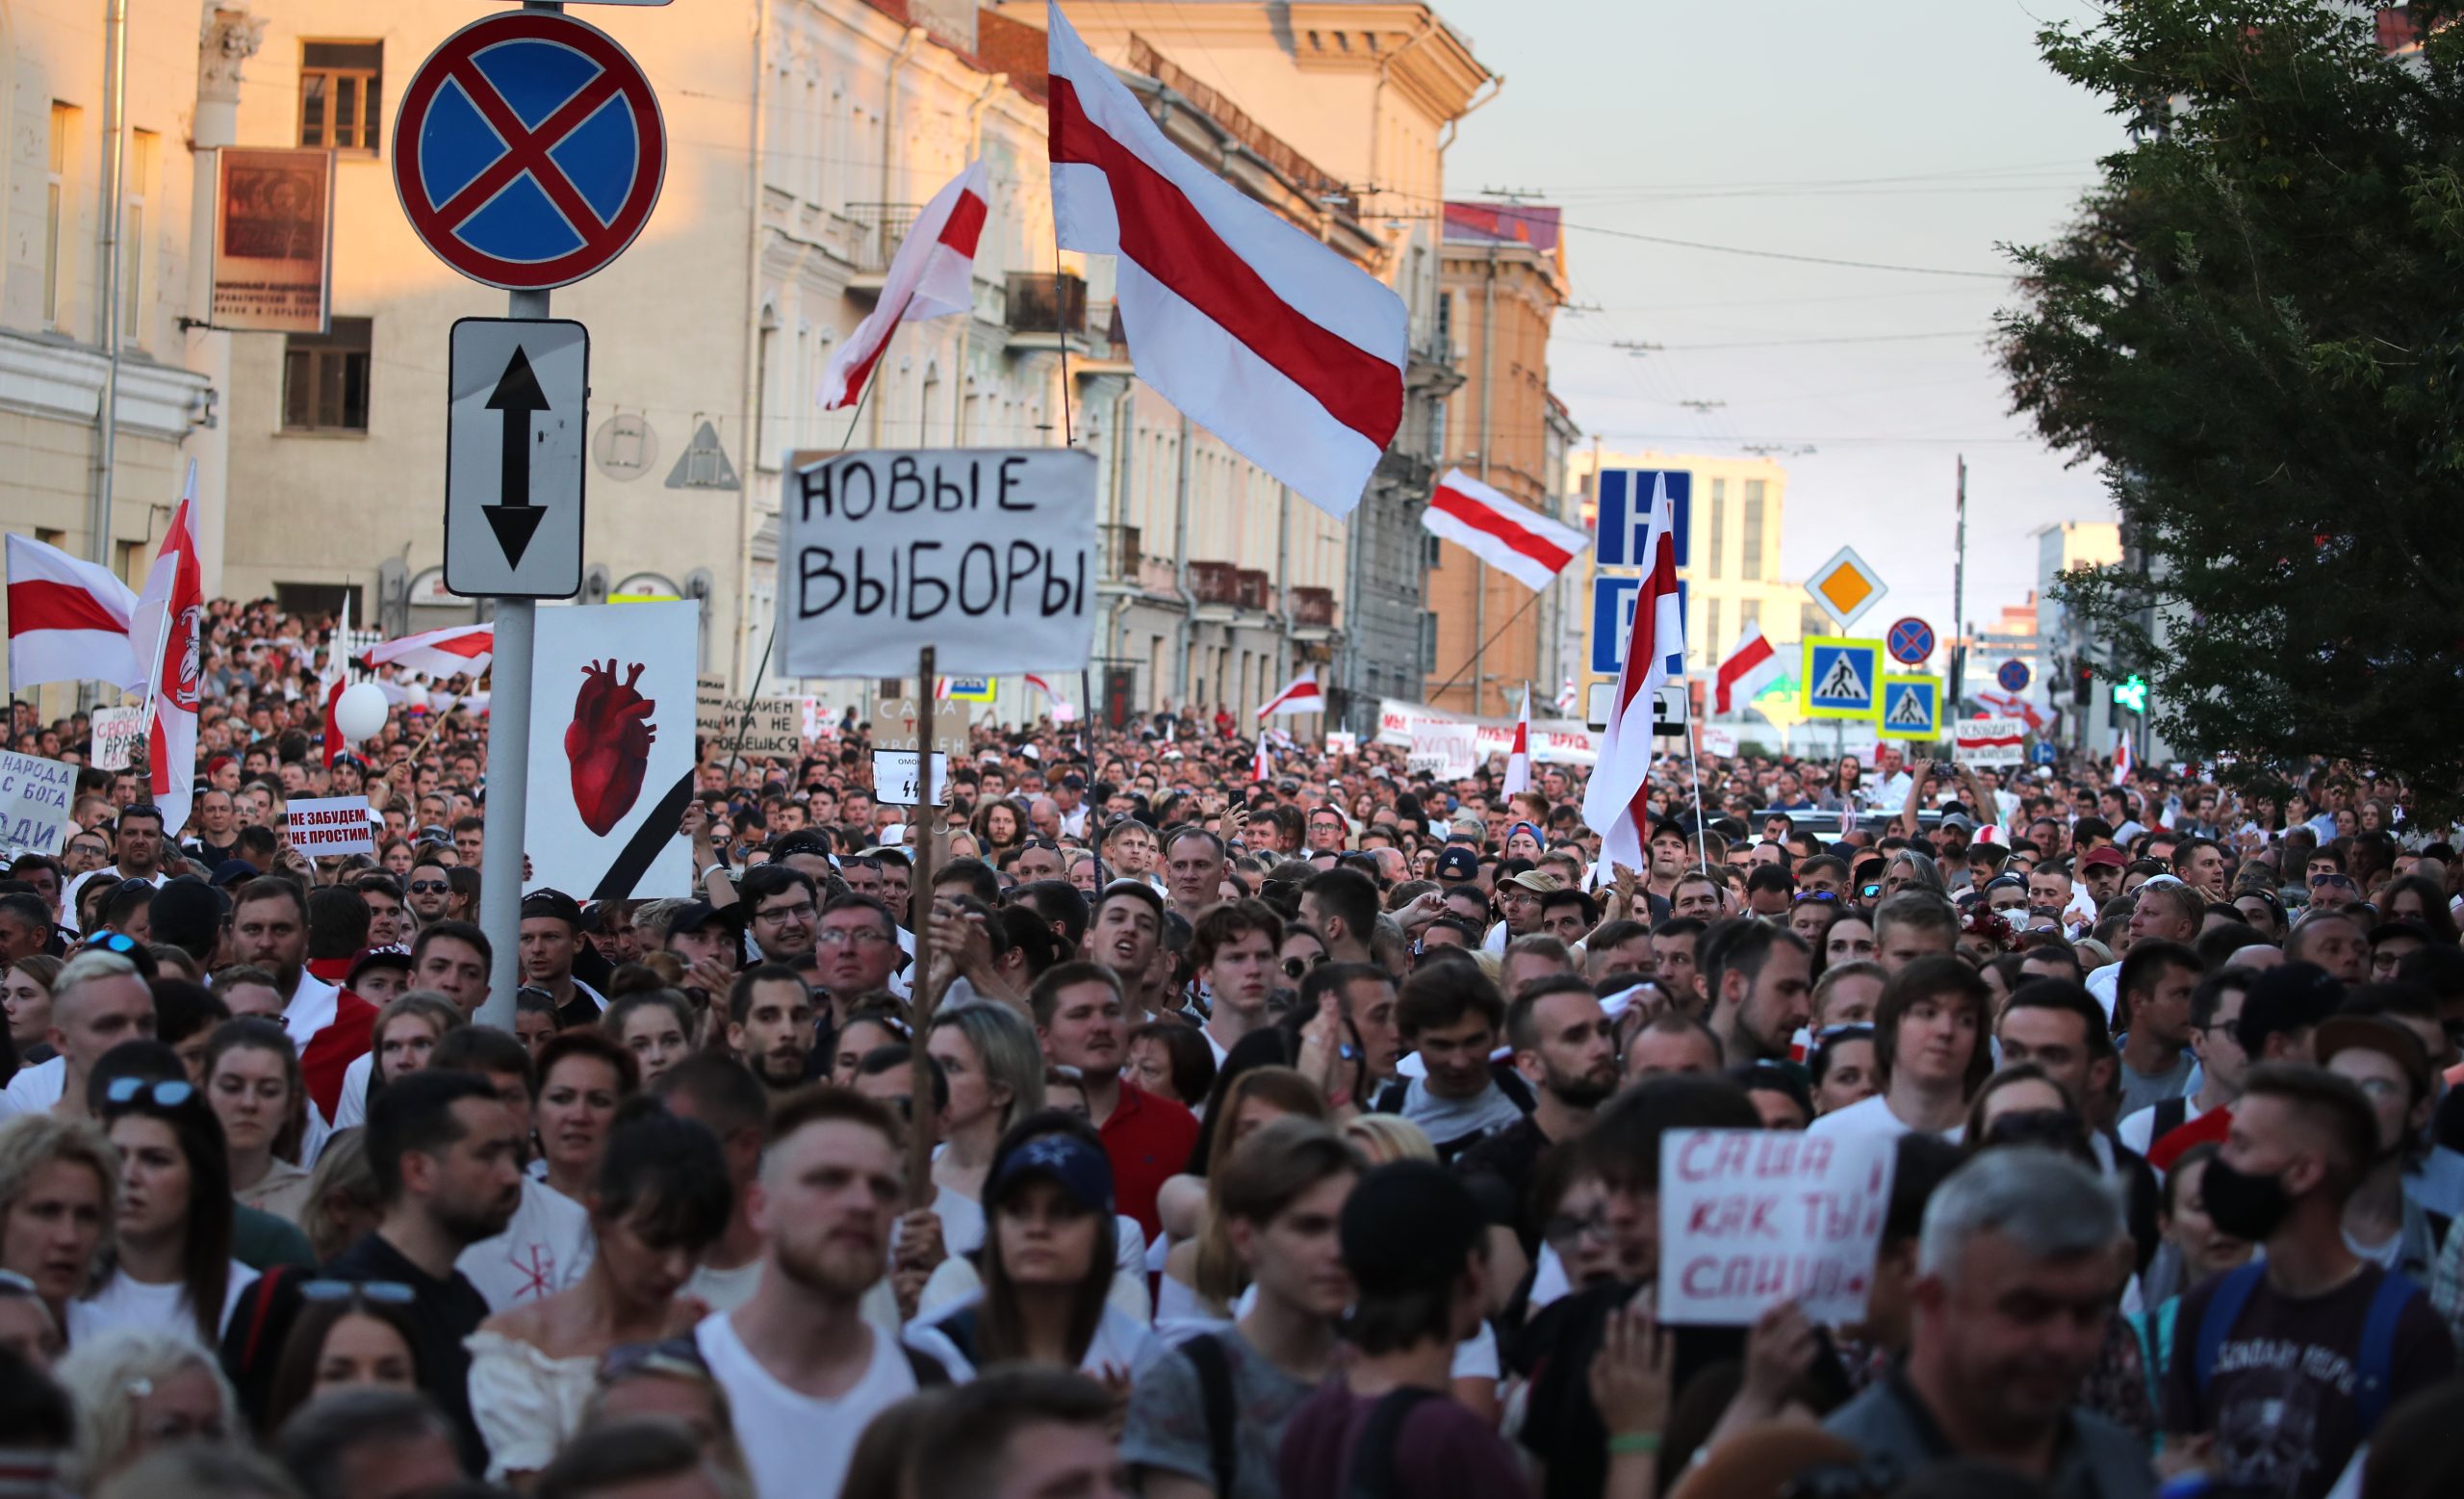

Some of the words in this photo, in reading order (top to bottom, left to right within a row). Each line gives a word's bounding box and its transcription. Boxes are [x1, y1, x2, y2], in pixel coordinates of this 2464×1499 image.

[800, 455, 1037, 522] НОВЫЕ
[798, 539, 1086, 621] ВЫБОРЫ
[724, 700, 793, 713] АСИЛИЕМ
[880, 700, 956, 720] САА
[771, 717, 791, 732] НЕ
[879, 737, 963, 755] УВОЕН
[2, 756, 69, 786] НАРОДА
[3, 776, 14, 792] С
[23, 782, 66, 809] БОГА
[290, 813, 305, 826] НЕ
[307, 809, 370, 826] ЗАБУДЕМ.
[292, 832, 307, 845] НЕ
[309, 827, 372, 844] ПРОСТИМ.
[1677, 1129, 1835, 1182] САША
[1686, 1192, 1782, 1241] КАК
[1802, 1190, 1861, 1243] ТЫ
